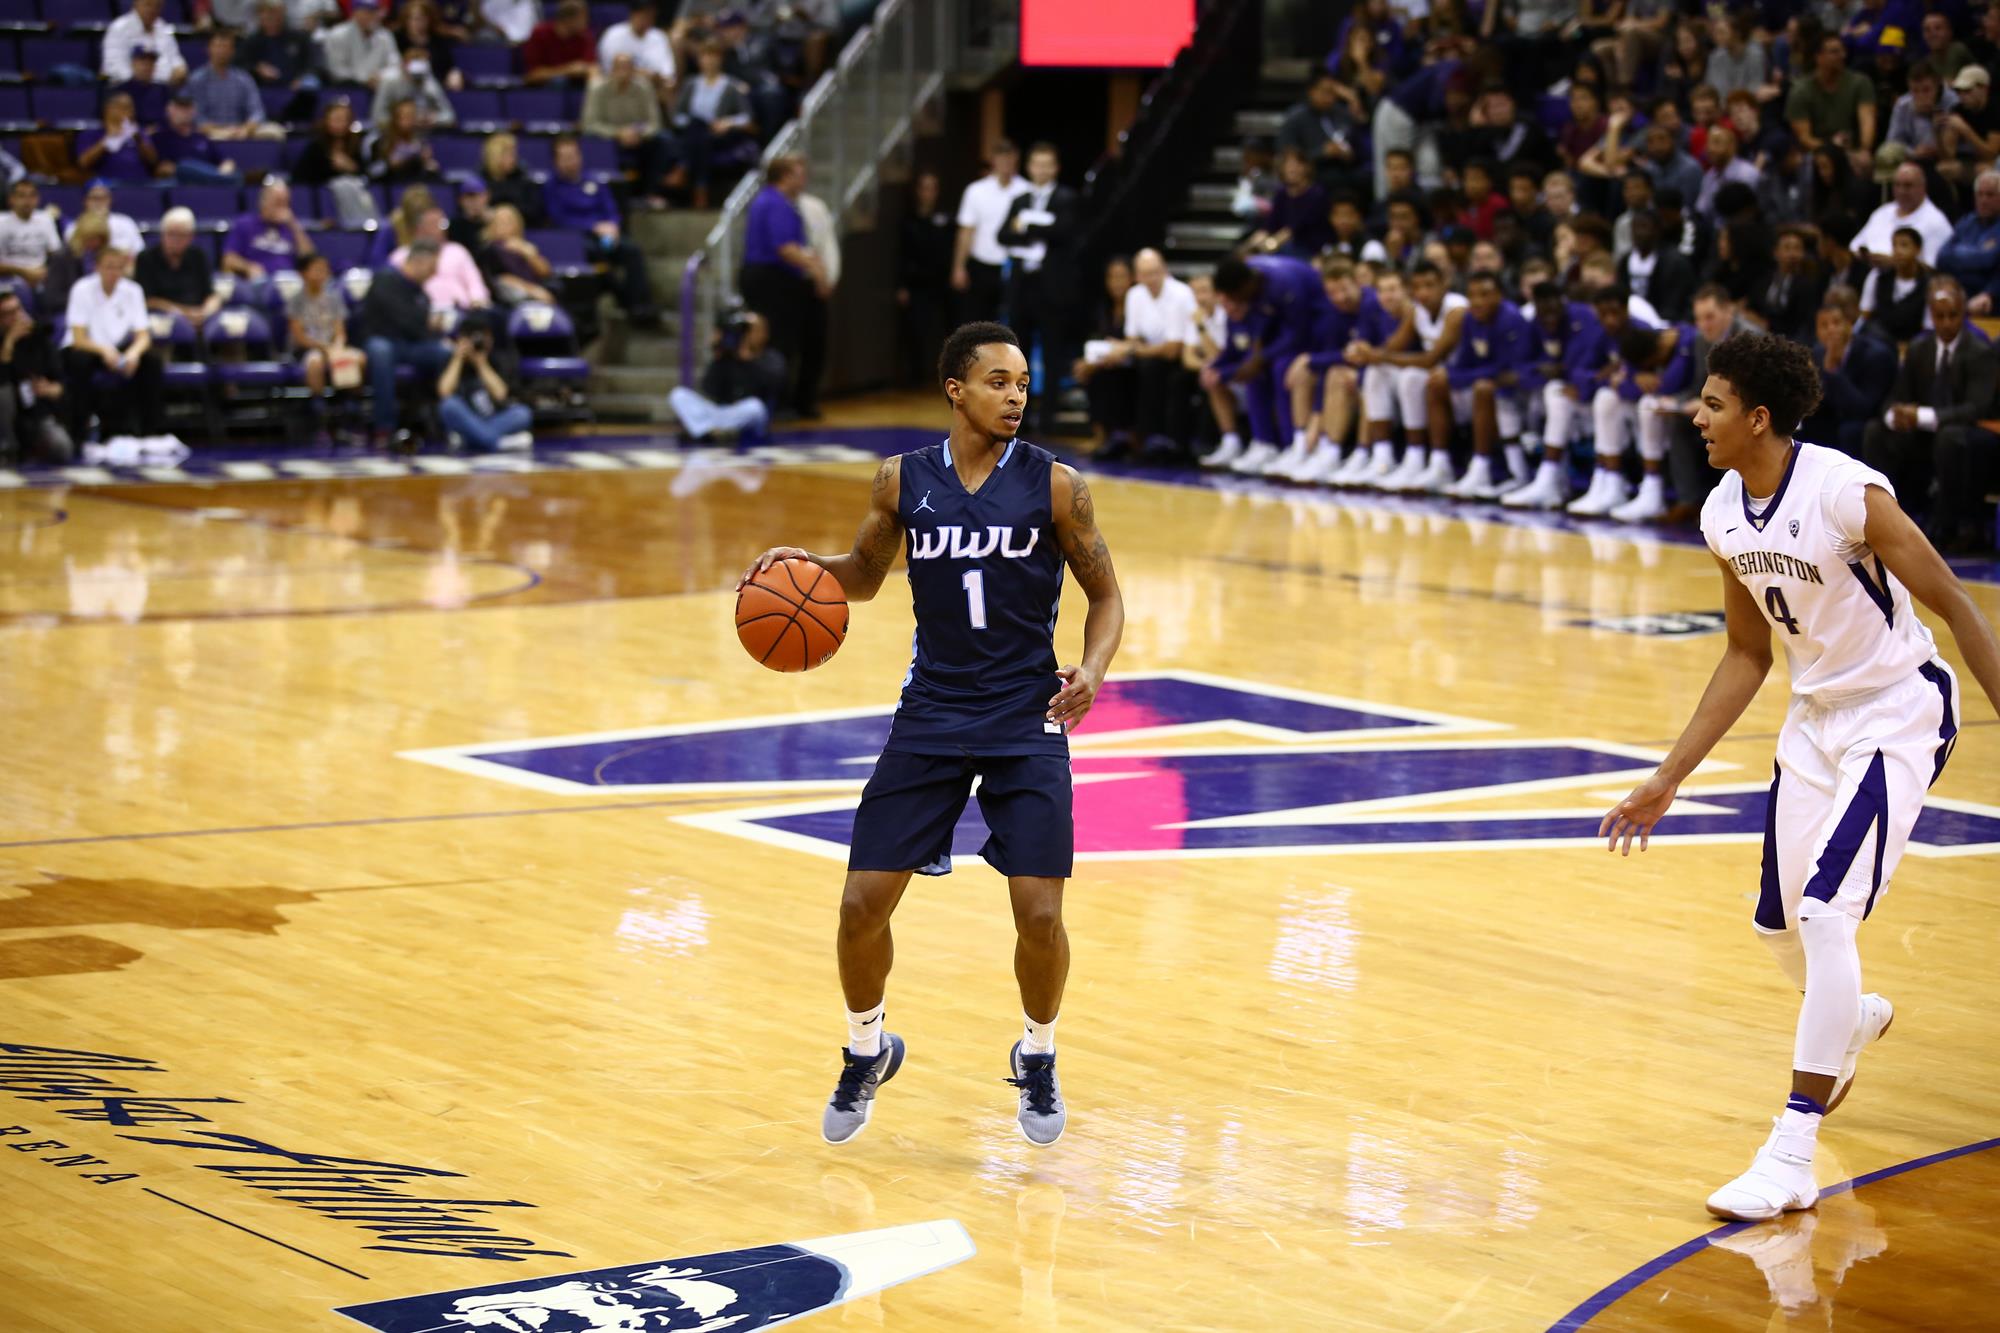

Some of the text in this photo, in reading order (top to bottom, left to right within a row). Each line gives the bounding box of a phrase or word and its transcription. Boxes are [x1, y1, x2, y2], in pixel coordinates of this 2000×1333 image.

[908, 525, 1040, 560] WWU
[1728, 550, 1825, 586] ASHINGTON
[961, 568, 988, 630] 1
[1764, 586, 1801, 635] 4
